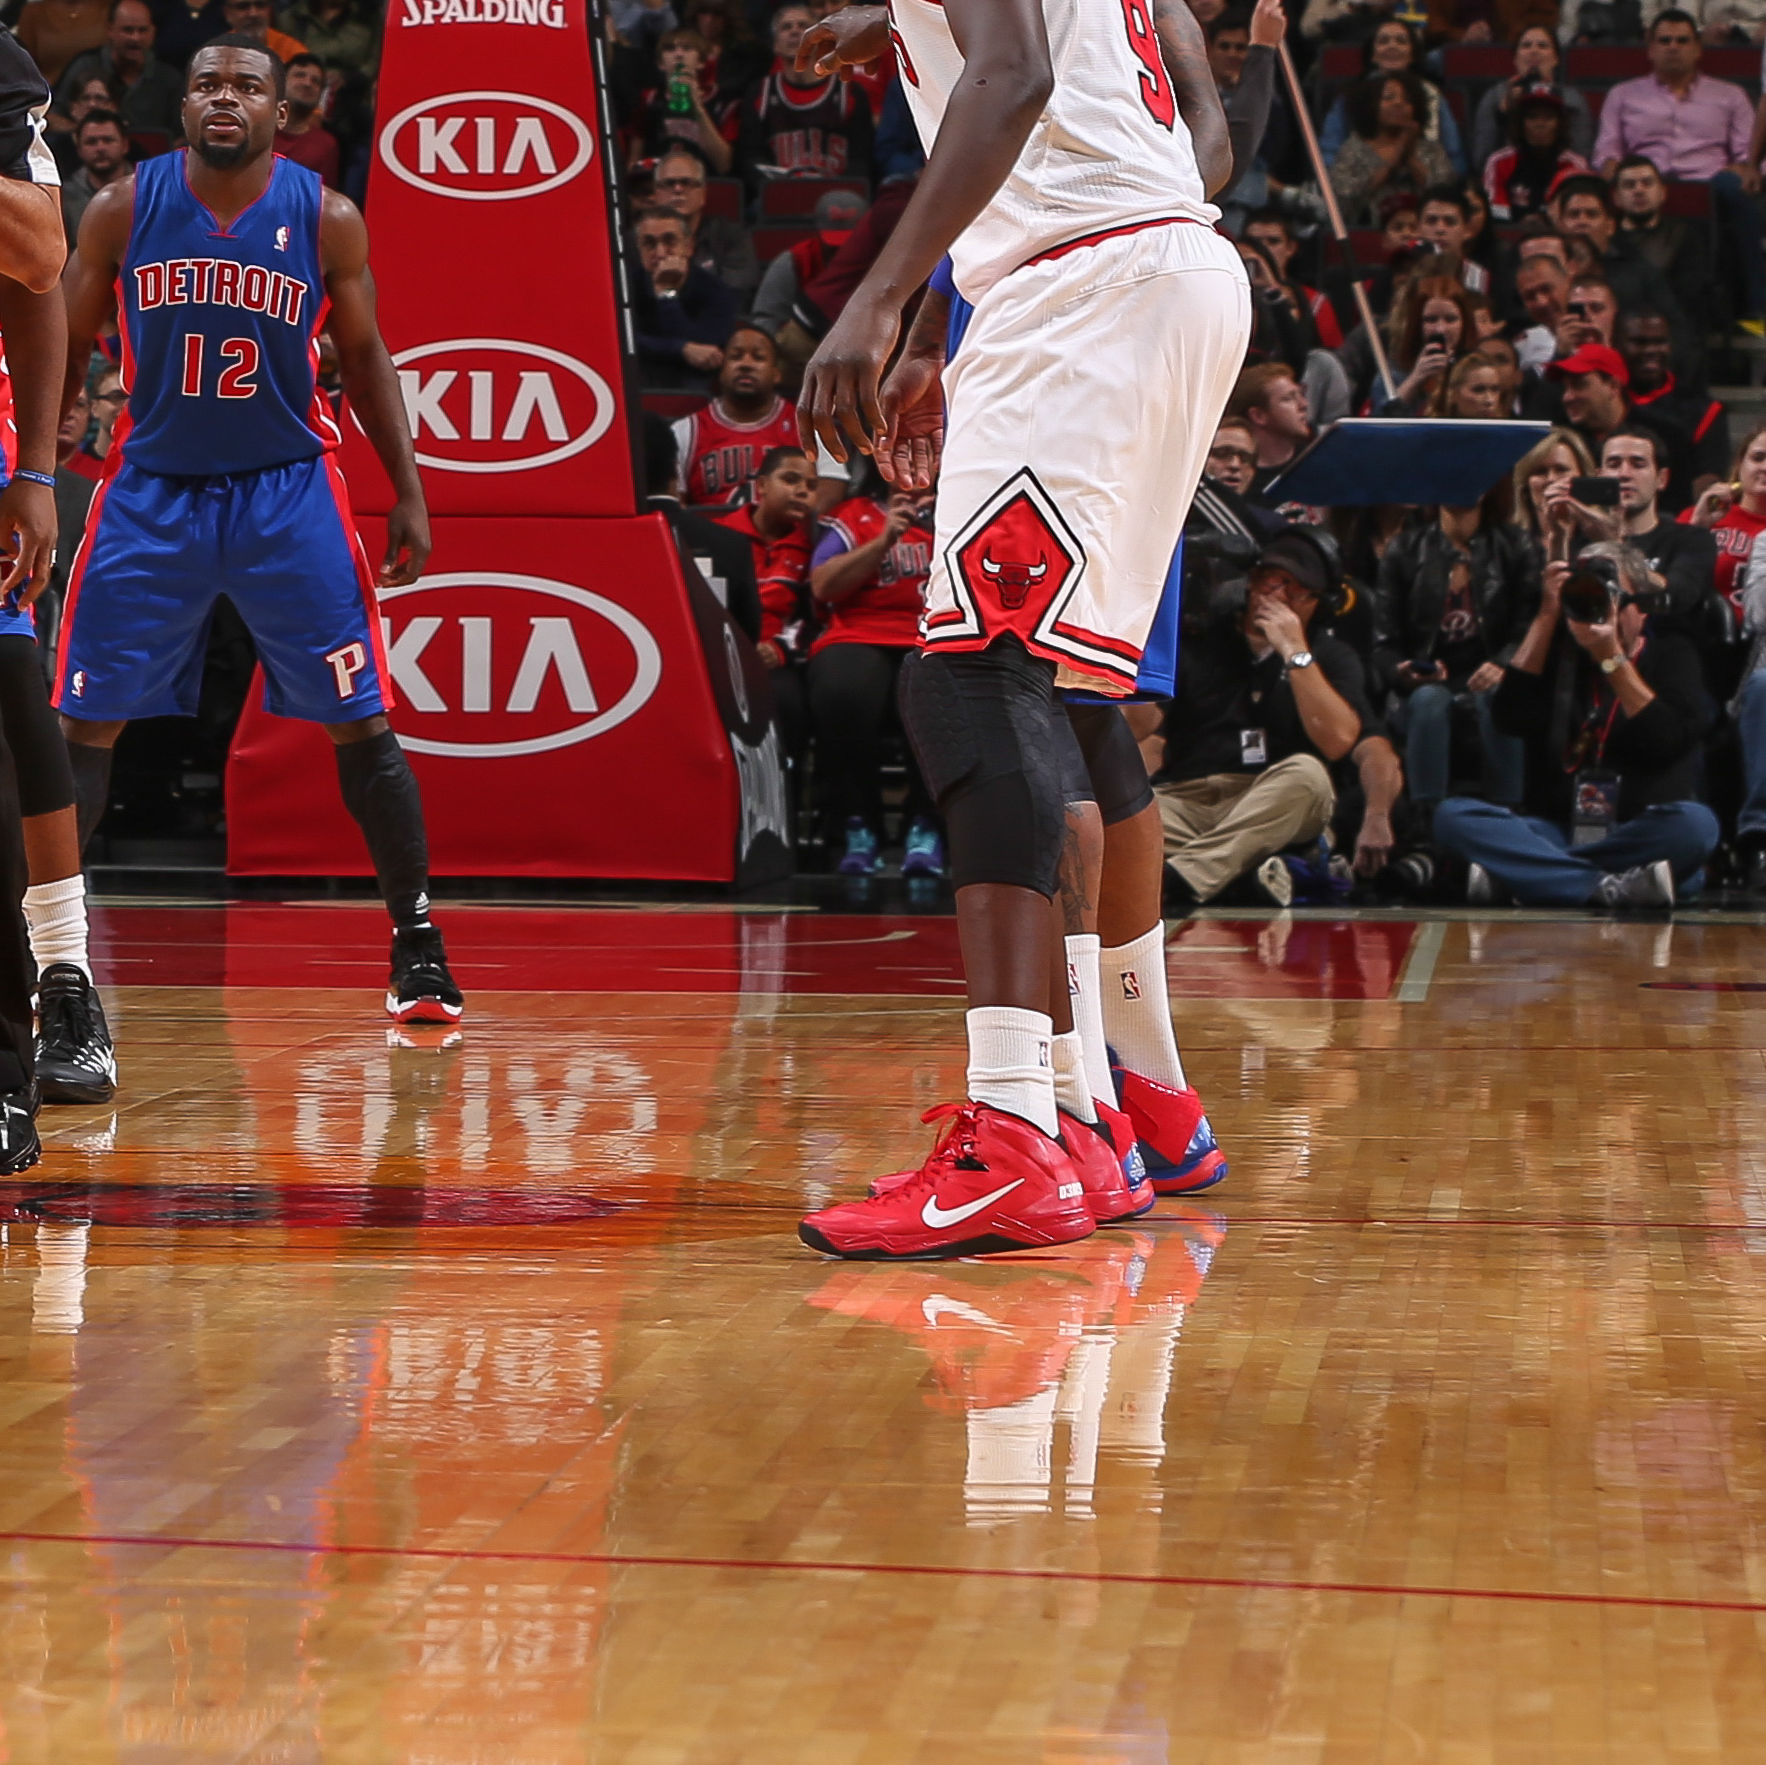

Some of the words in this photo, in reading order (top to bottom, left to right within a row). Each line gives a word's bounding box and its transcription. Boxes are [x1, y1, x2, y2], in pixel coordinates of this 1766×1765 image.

[417, 116, 559, 176] KIA
[133, 257, 309, 327] DETROIT
[182, 334, 260, 399] 12
[400, 370, 570, 442] KIA
[326, 641, 367, 699] P
[381, 616, 598, 714] KIA
